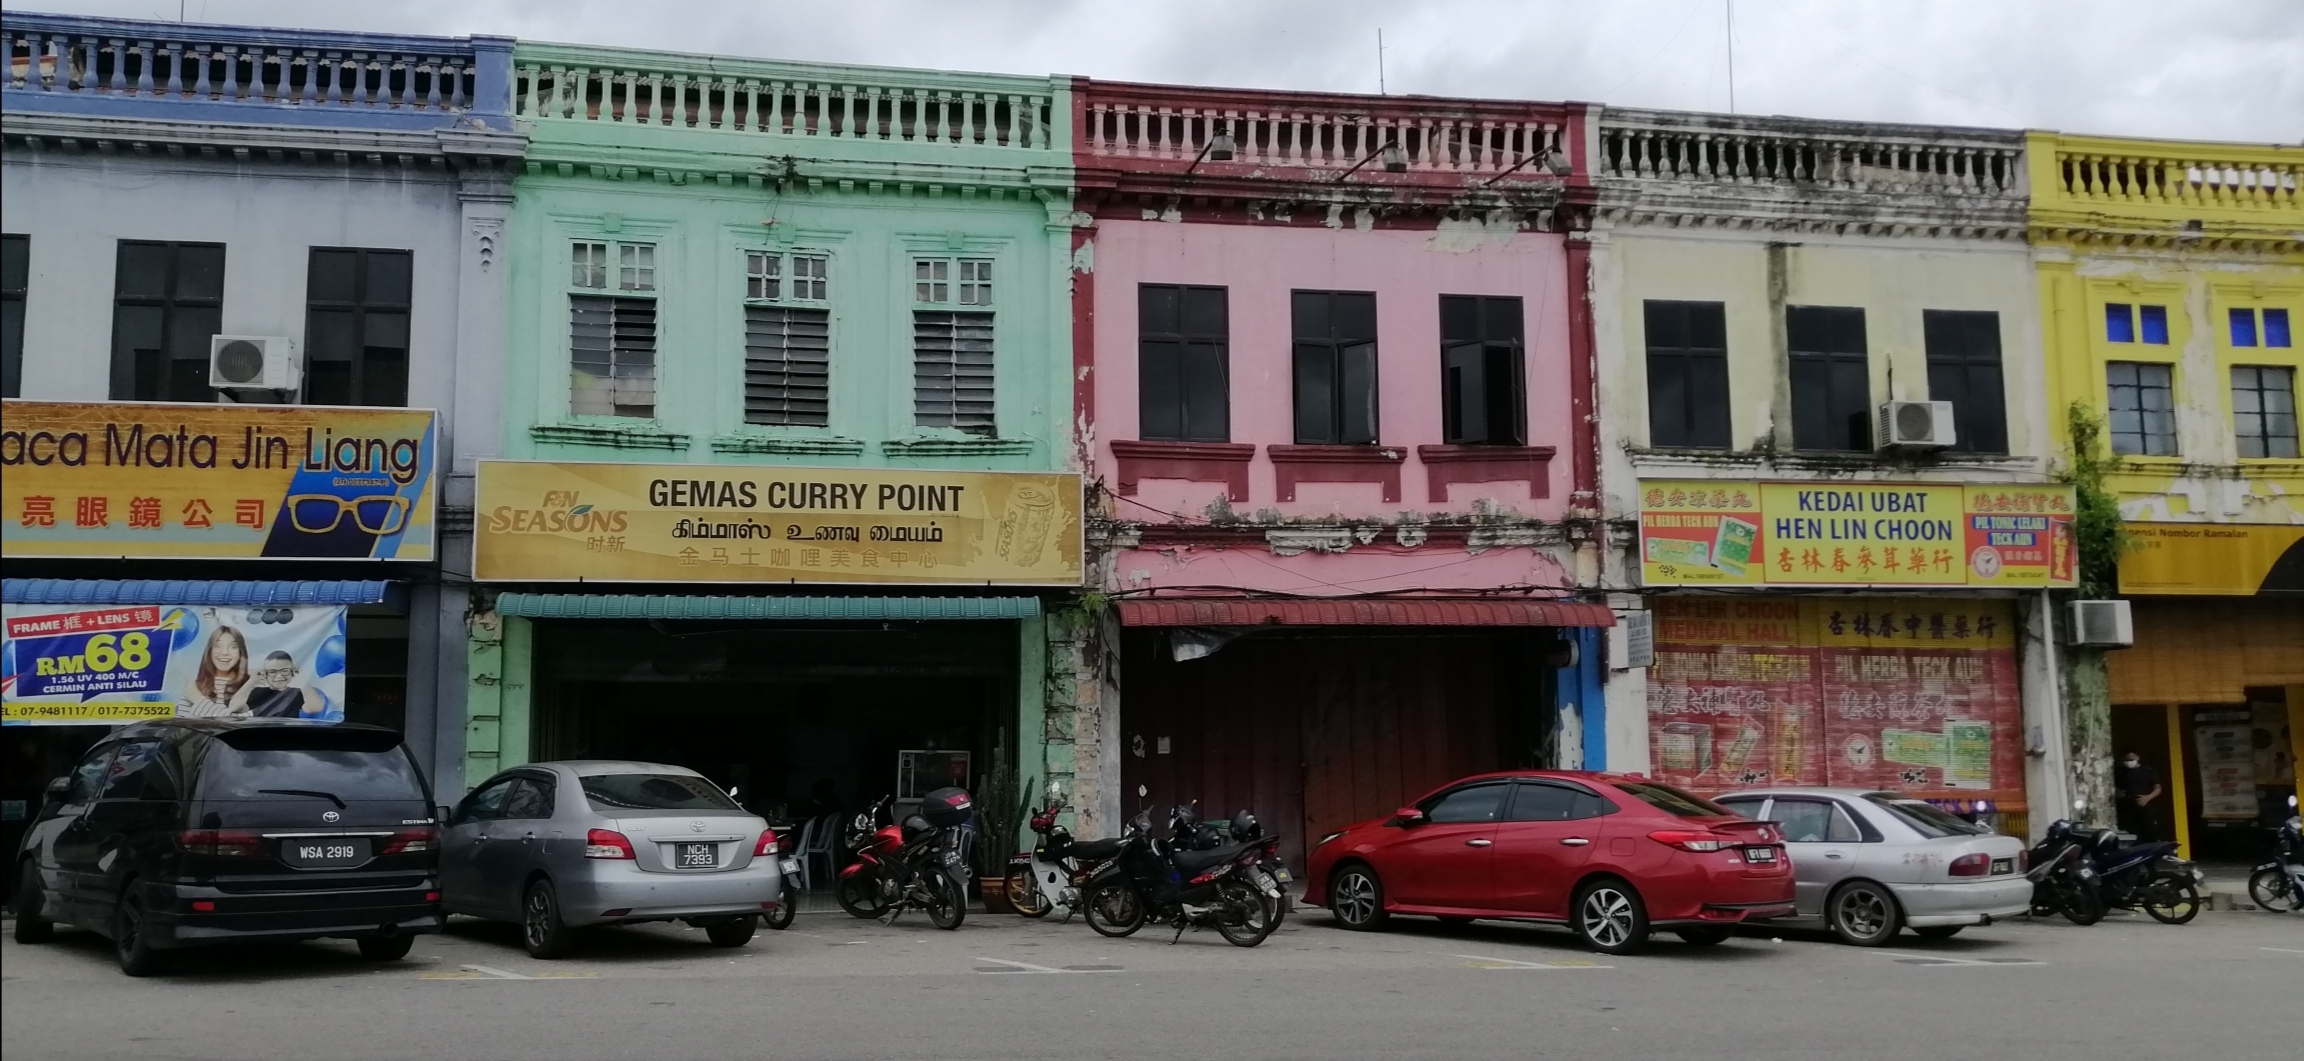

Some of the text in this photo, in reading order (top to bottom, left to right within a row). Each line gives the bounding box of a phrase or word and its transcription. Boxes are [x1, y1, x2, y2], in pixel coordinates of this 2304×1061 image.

[105, 423, 217, 468] Mata
[232, 426, 288, 470] Jin
[305, 427, 418, 483] Liang
[542, 490, 579, 507] F&N
[649, 479, 964, 511] GEMAS CURRY POINT
[1799, 491, 1928, 513] KEDAI UBAT
[21, 495, 264, 529] 亮眼鏡公司
[490, 505, 628, 533] SEASONS
[672, 517, 943, 542] கிம்மாஸ் உணவு மையம்
[1776, 518, 1952, 540] HEN LIN CHOON
[2159, 529, 2200, 538] Nombor
[2203, 529, 2248, 538] Ramalan
[586, 536, 626, 553] 时新
[679, 546, 938, 569] 金马士咖哩美食中心
[1735, 601, 1799, 620] CHOON
[13, 609, 153, 634] FRAME 框 + LENS 镜
[1659, 620, 1740, 640] MEDICAL
[1747, 622, 1793, 641] HALL
[36, 632, 151, 676] RM68
[52, 671, 139, 684] 1.56 UV 400 M/C
[1835, 655, 1858, 681] PIL
[1860, 655, 1909, 681] HERBA
[1913, 656, 1951, 682] TECK
[43, 680, 147, 693] CERMIN ANTI SILAU
[20, 707, 87, 716] 07-9481117
[98, 706, 171, 715] 017-7375522
[300, 846, 354, 859] WSA 2919
[684, 854, 712, 865] 7393
[687, 844, 709, 855] NCH
